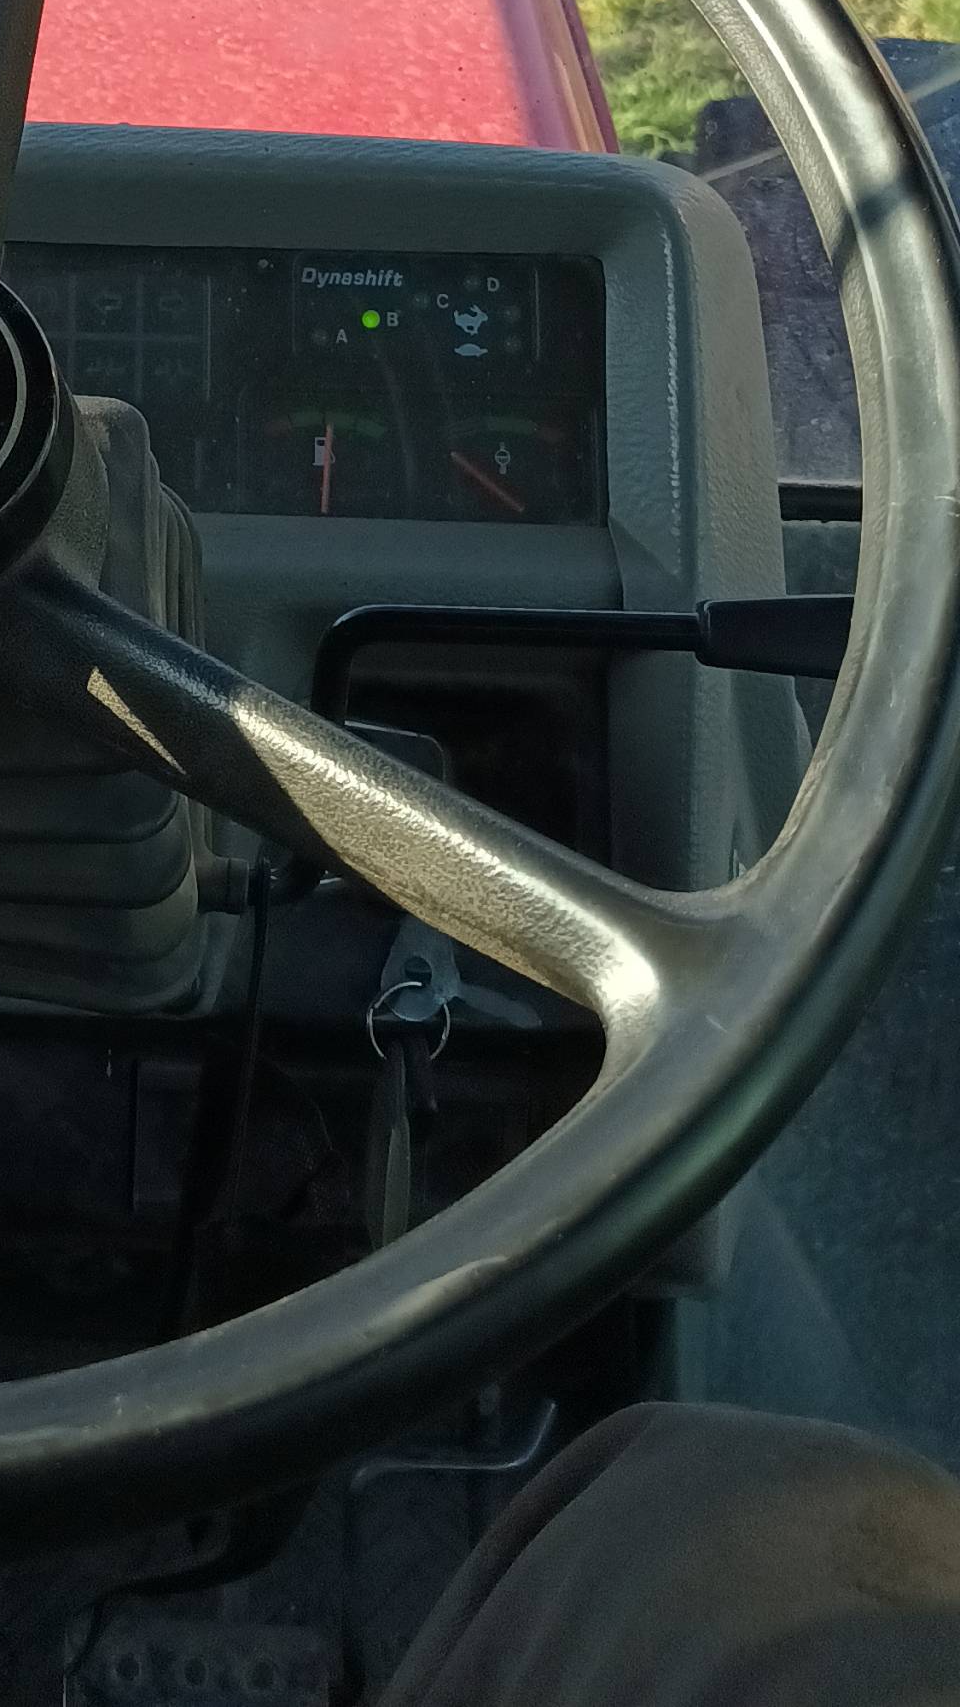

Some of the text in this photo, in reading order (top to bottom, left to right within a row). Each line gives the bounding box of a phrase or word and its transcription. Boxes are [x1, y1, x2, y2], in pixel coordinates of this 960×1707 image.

[301, 267, 404, 289] Dynashift
[486, 277, 500, 292] D
[436, 293, 450, 309] C
[386, 311, 400, 327] B
[335, 328, 349, 344] A
